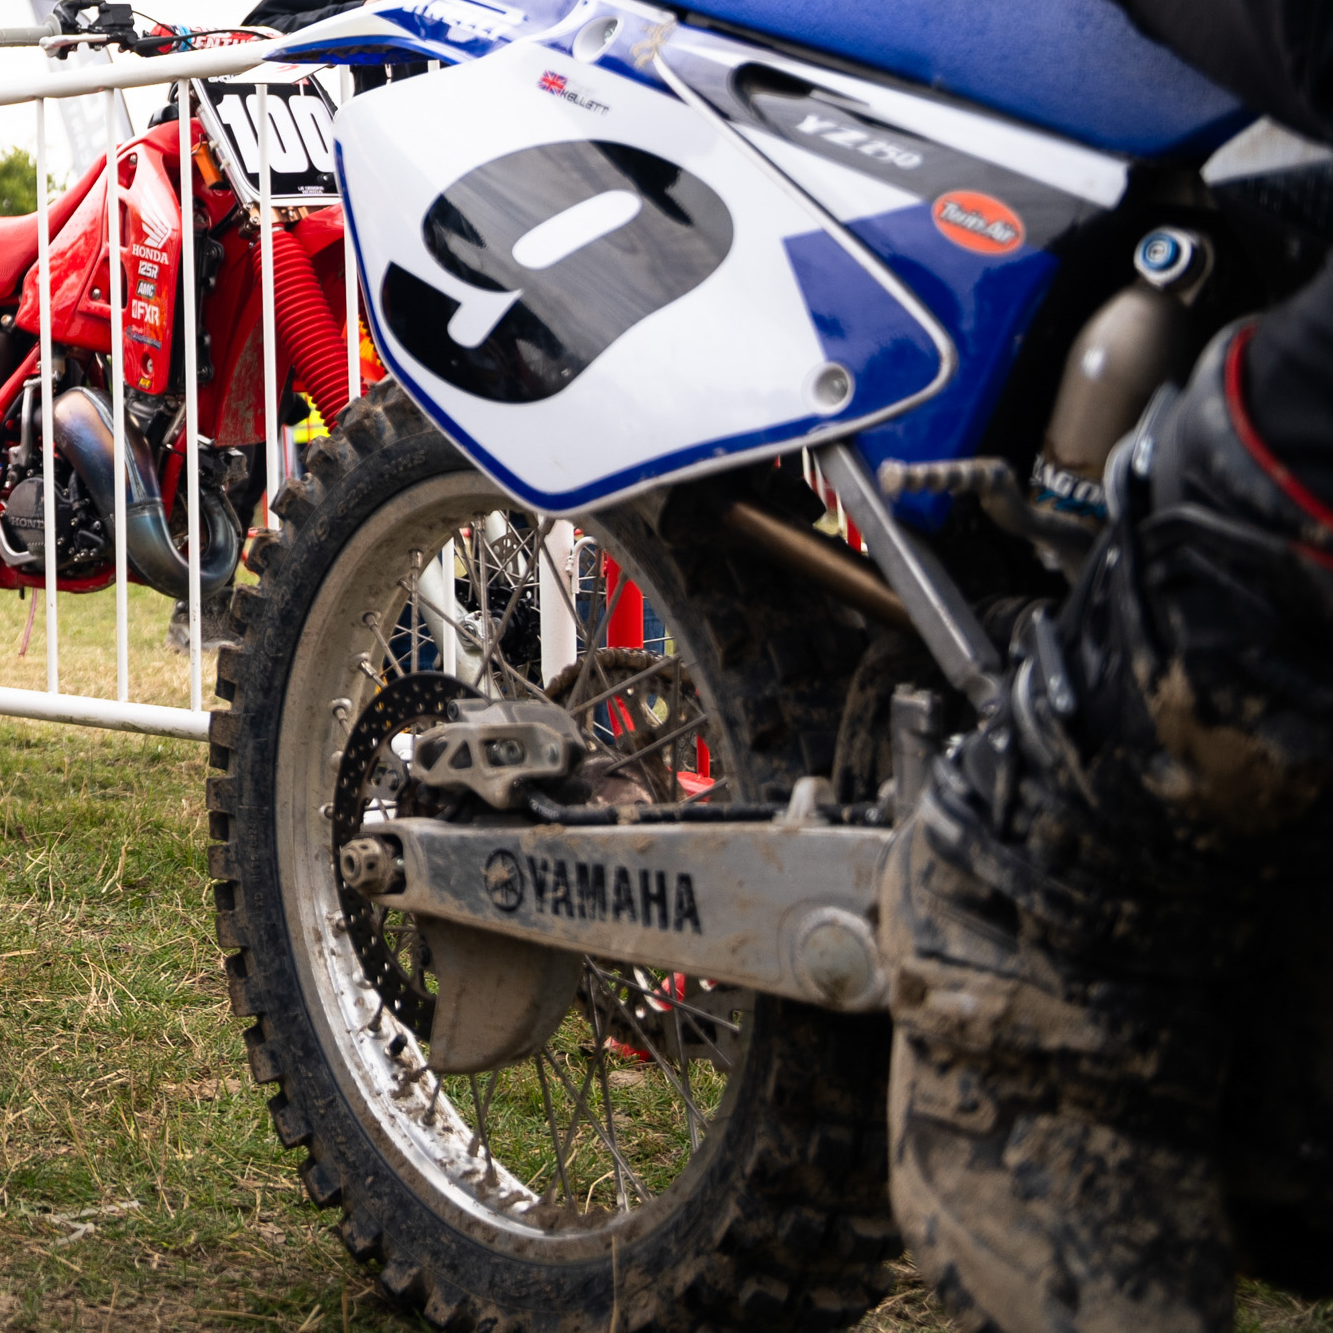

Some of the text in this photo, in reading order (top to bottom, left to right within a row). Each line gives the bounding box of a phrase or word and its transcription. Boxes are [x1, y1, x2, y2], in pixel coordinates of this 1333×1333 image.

[561, 87, 610, 116] KELLETT
[216, 94, 335, 174] 100
[939, 200, 1017, 244] Twin Air
[132, 243, 169, 265] HONDA
[137, 280, 155, 297] AMC
[525, 854, 702, 936] YAMAHA
